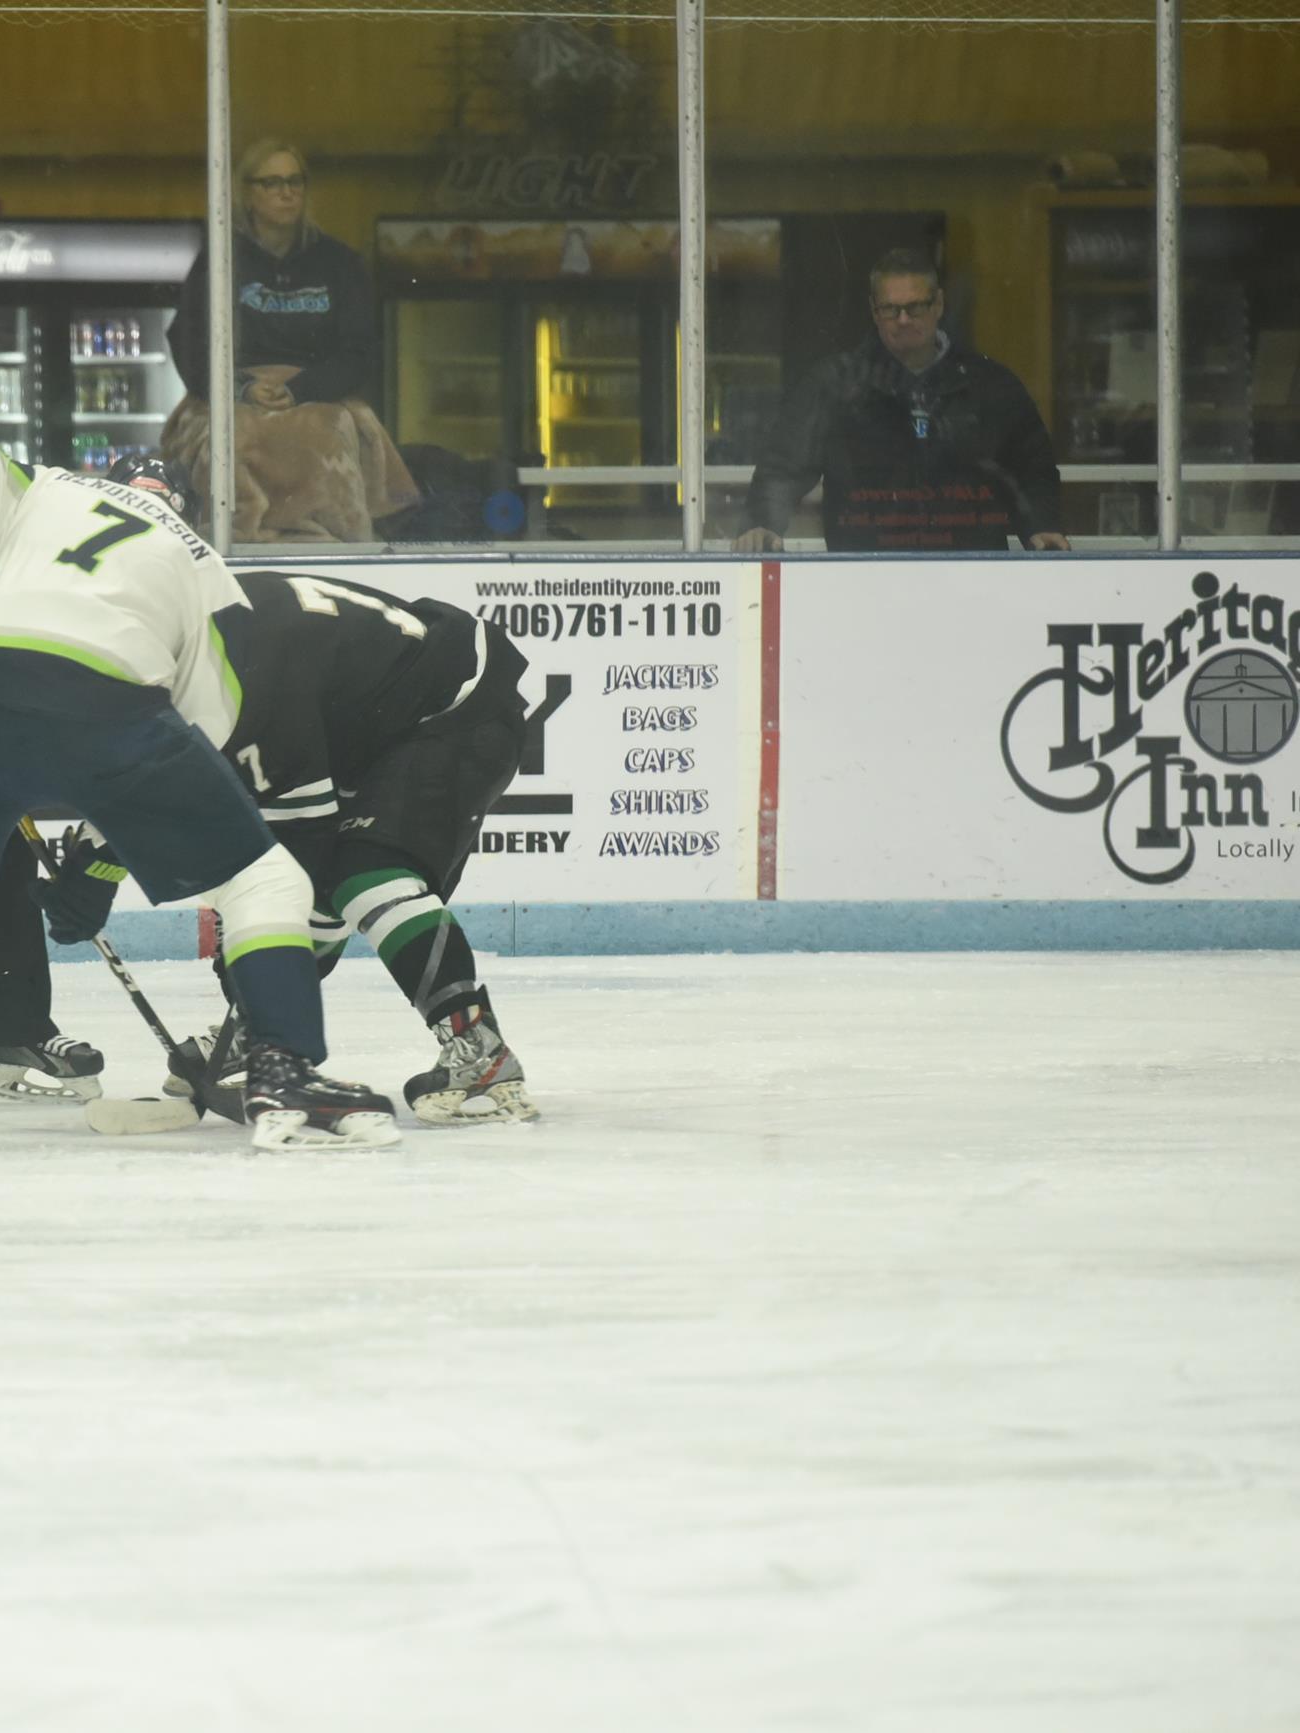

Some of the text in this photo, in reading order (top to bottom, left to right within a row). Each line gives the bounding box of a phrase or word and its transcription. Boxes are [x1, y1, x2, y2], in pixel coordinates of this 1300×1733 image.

[53, 499, 156, 576] 7
[475, 579, 721, 599] www.theidentityzone.com
[602, 664, 720, 696] JACKETS
[1001, 571, 1300, 814] Herita
[622, 706, 698, 732] BAGS
[624, 748, 695, 773] CAPS
[609, 789, 709, 816] SHIRTS
[1102, 736, 1269, 885] Inn
[598, 831, 721, 857] AWARDS
[1217, 838, 1295, 863] Locally
